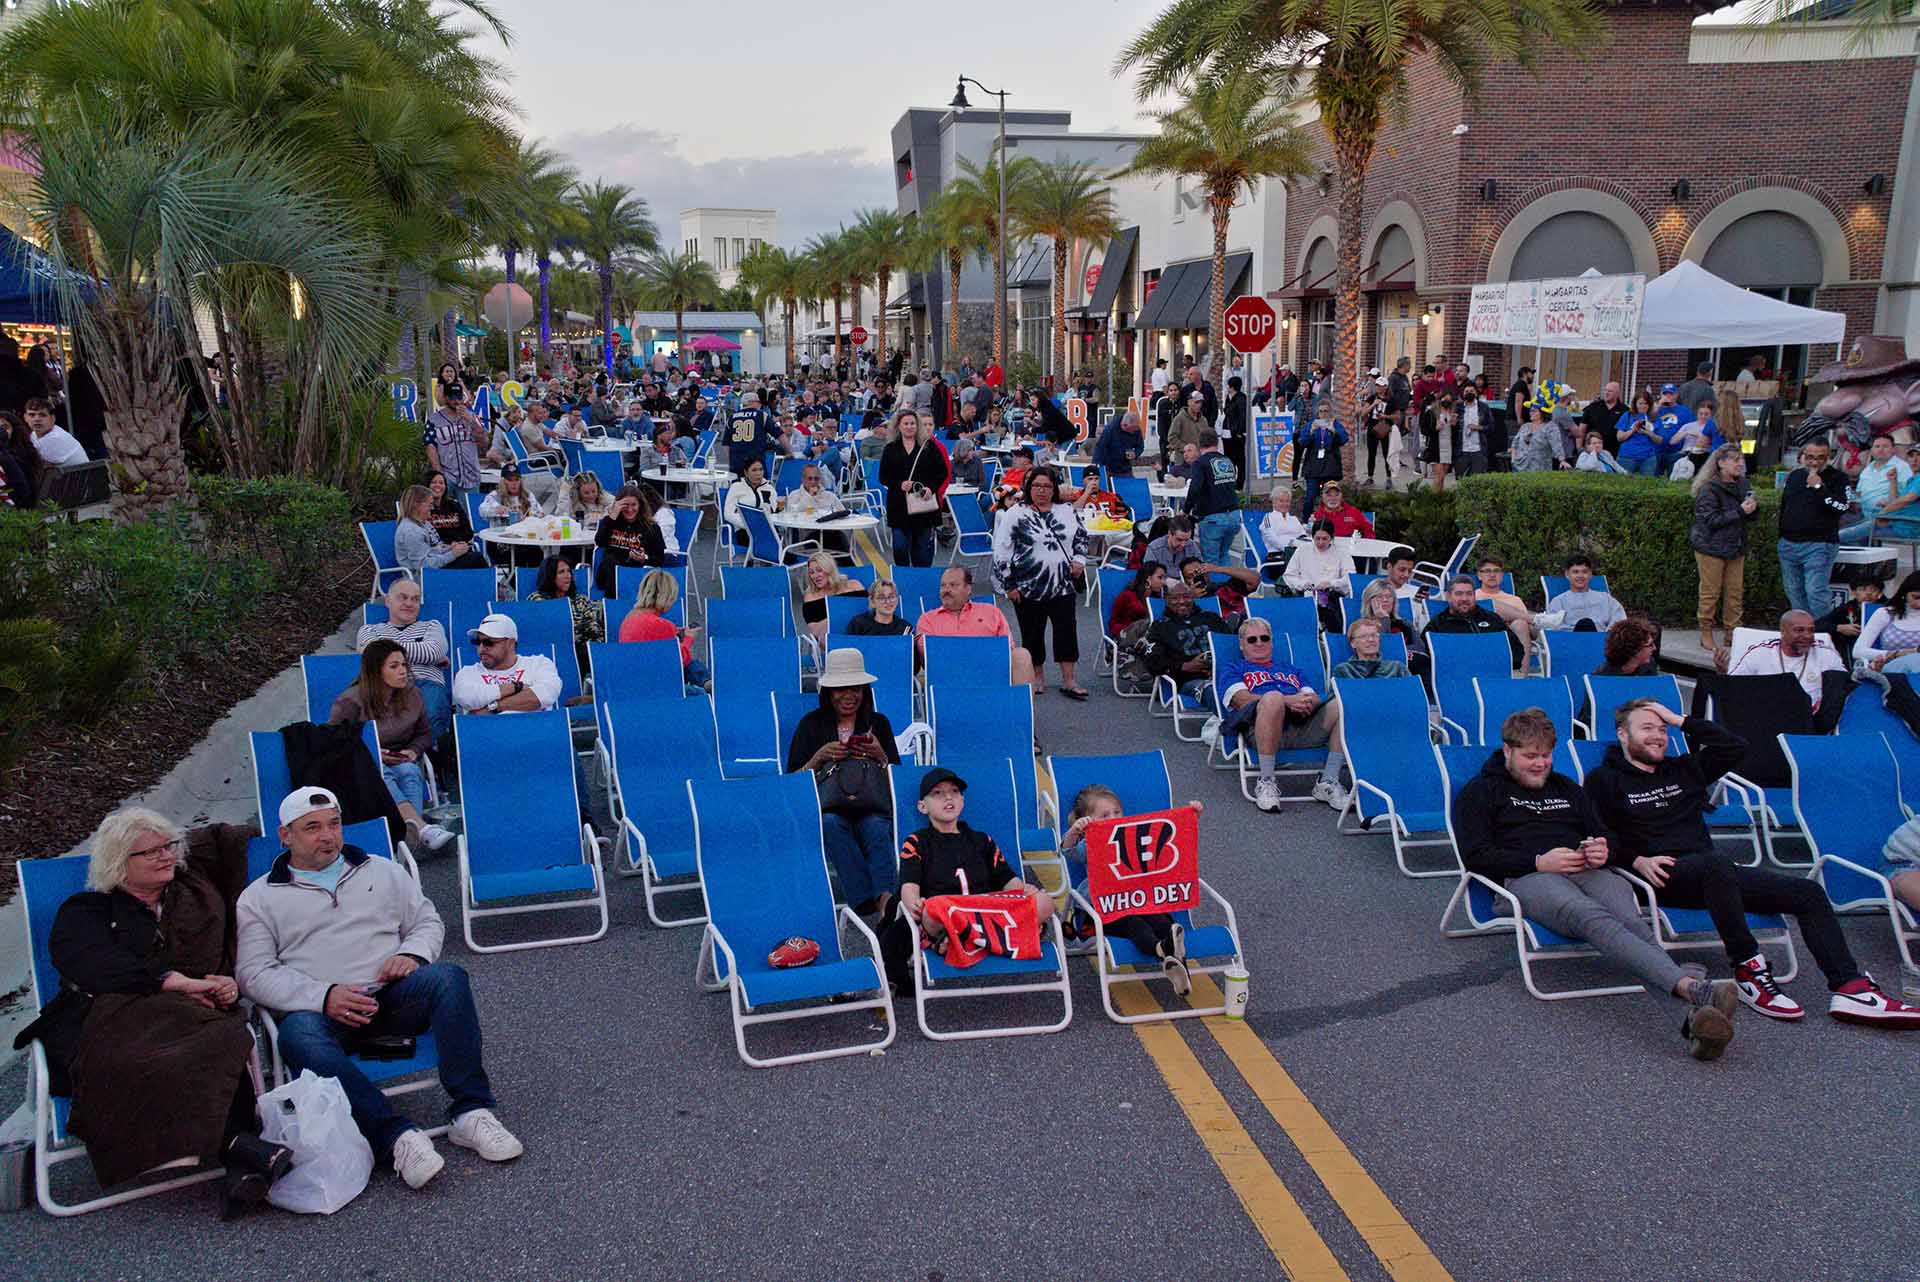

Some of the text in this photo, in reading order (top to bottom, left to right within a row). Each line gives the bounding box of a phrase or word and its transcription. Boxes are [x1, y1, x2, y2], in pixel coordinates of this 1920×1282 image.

[1544, 285, 1588, 298] MARGARITAS
[1549, 301, 1580, 312] CERVEZA
[1228, 314, 1273, 336] STOP
[1543, 313, 1585, 334] TACOS
[851, 331, 867, 340] STOP
[732, 419, 755, 442] 30
[955, 867, 970, 896] 1
[1099, 882, 1192, 914] WHO DEY
